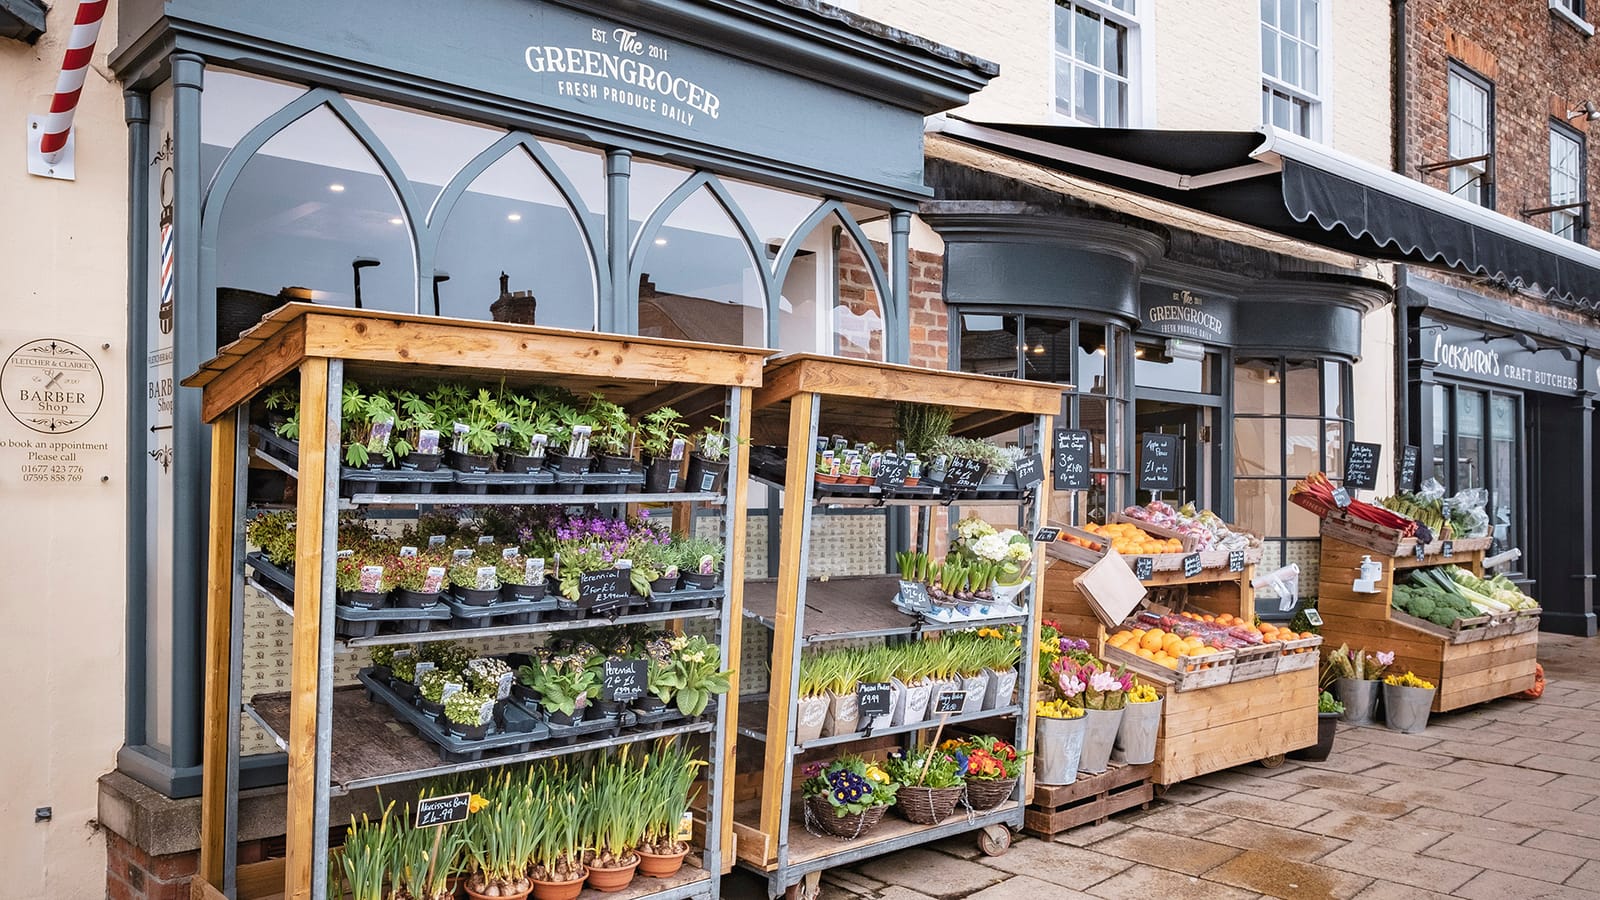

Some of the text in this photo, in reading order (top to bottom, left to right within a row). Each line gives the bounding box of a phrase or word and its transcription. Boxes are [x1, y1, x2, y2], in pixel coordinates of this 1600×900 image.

[592, 28, 668, 61] EST. The 2011
[525, 46, 720, 119] GREENGROCER
[558, 81, 694, 127] FRESH PRODUCE DAILY
[1149, 305, 1222, 335] GREENGROCER
[1161, 324, 1176, 333] FRESH
[1177, 324, 1198, 337] PRODUCE
[11, 357, 51, 367] FLETCHER
[59, 361, 95, 370] CLARKE'S
[1434, 334, 1500, 377] COCKBURN'S
[1503, 364, 1532, 382] CRAFT
[1535, 371, 1578, 391] BUTCHERS
[148, 378, 173, 399] BARB
[20, 390, 86, 404] BARBER
[38, 402, 68, 414] Shop
[8, 439, 32, 448] book
[49, 441, 108, 452] appointment
[28, 452, 76, 461] Please call
[21, 465, 84, 474] 01677 423 776
[23, 474, 82, 482] 07595 858 769
[581, 570, 620, 584] Perennial
[582, 584, 590, 596] 2
[602, 582, 616, 593] £6
[604, 676, 613, 688] 2
[623, 675, 635, 687] £6
